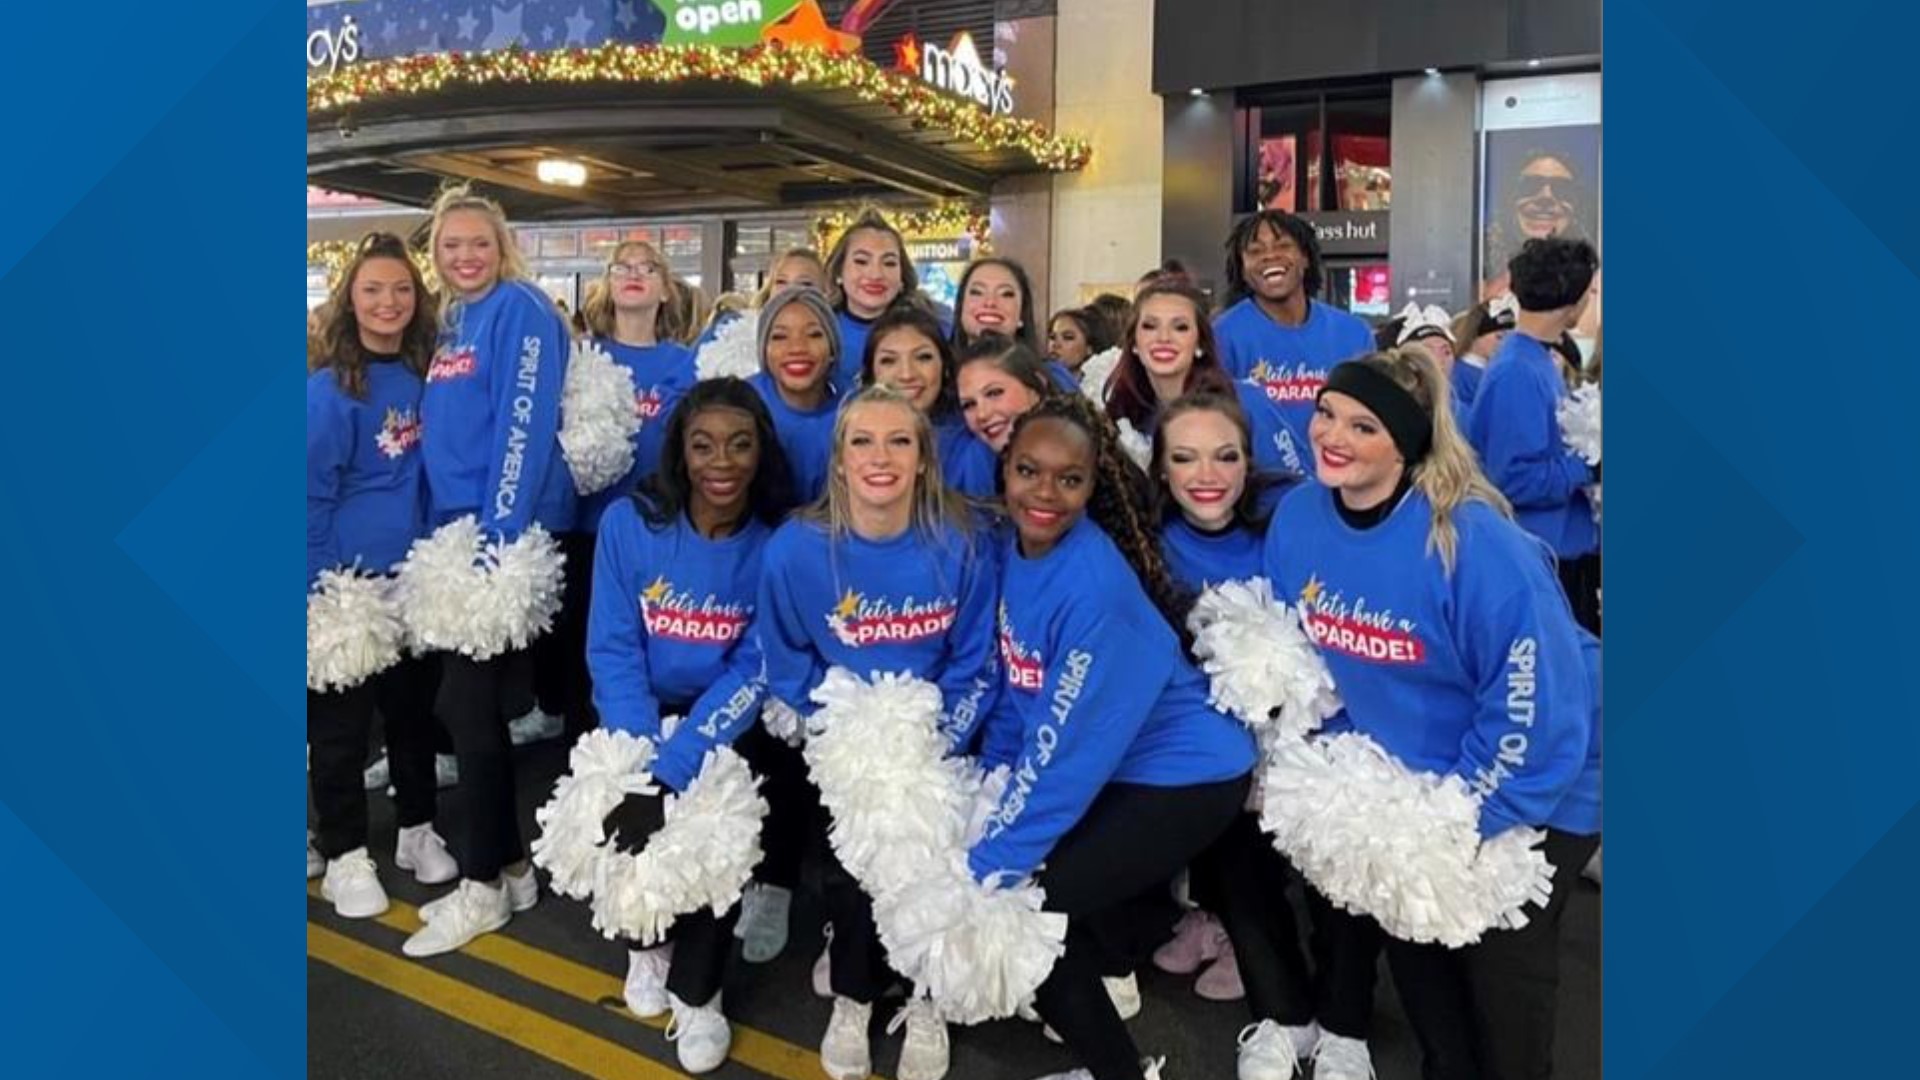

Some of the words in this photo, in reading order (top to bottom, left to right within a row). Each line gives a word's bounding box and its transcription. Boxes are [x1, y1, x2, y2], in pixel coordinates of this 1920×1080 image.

[675, 0, 762, 34] open
[307, 15, 358, 75] cy's
[1346, 220, 1376, 240] hut
[516, 335, 541, 394] SPIRIT
[512, 397, 532, 423] OF
[494, 425, 528, 519] AMERICA
[858, 594, 897, 621] let's
[902, 595, 947, 618] have
[1317, 590, 1351, 626] let's
[1353, 597, 1395, 632] have
[1398, 618, 1417, 632] a
[1312, 620, 1416, 660] PARADE!
[1051, 649, 1094, 725] SPIRIT
[1506, 637, 1537, 728] SPIRIT
[943, 676, 990, 744] AMERI
[1037, 724, 1058, 767] OF
